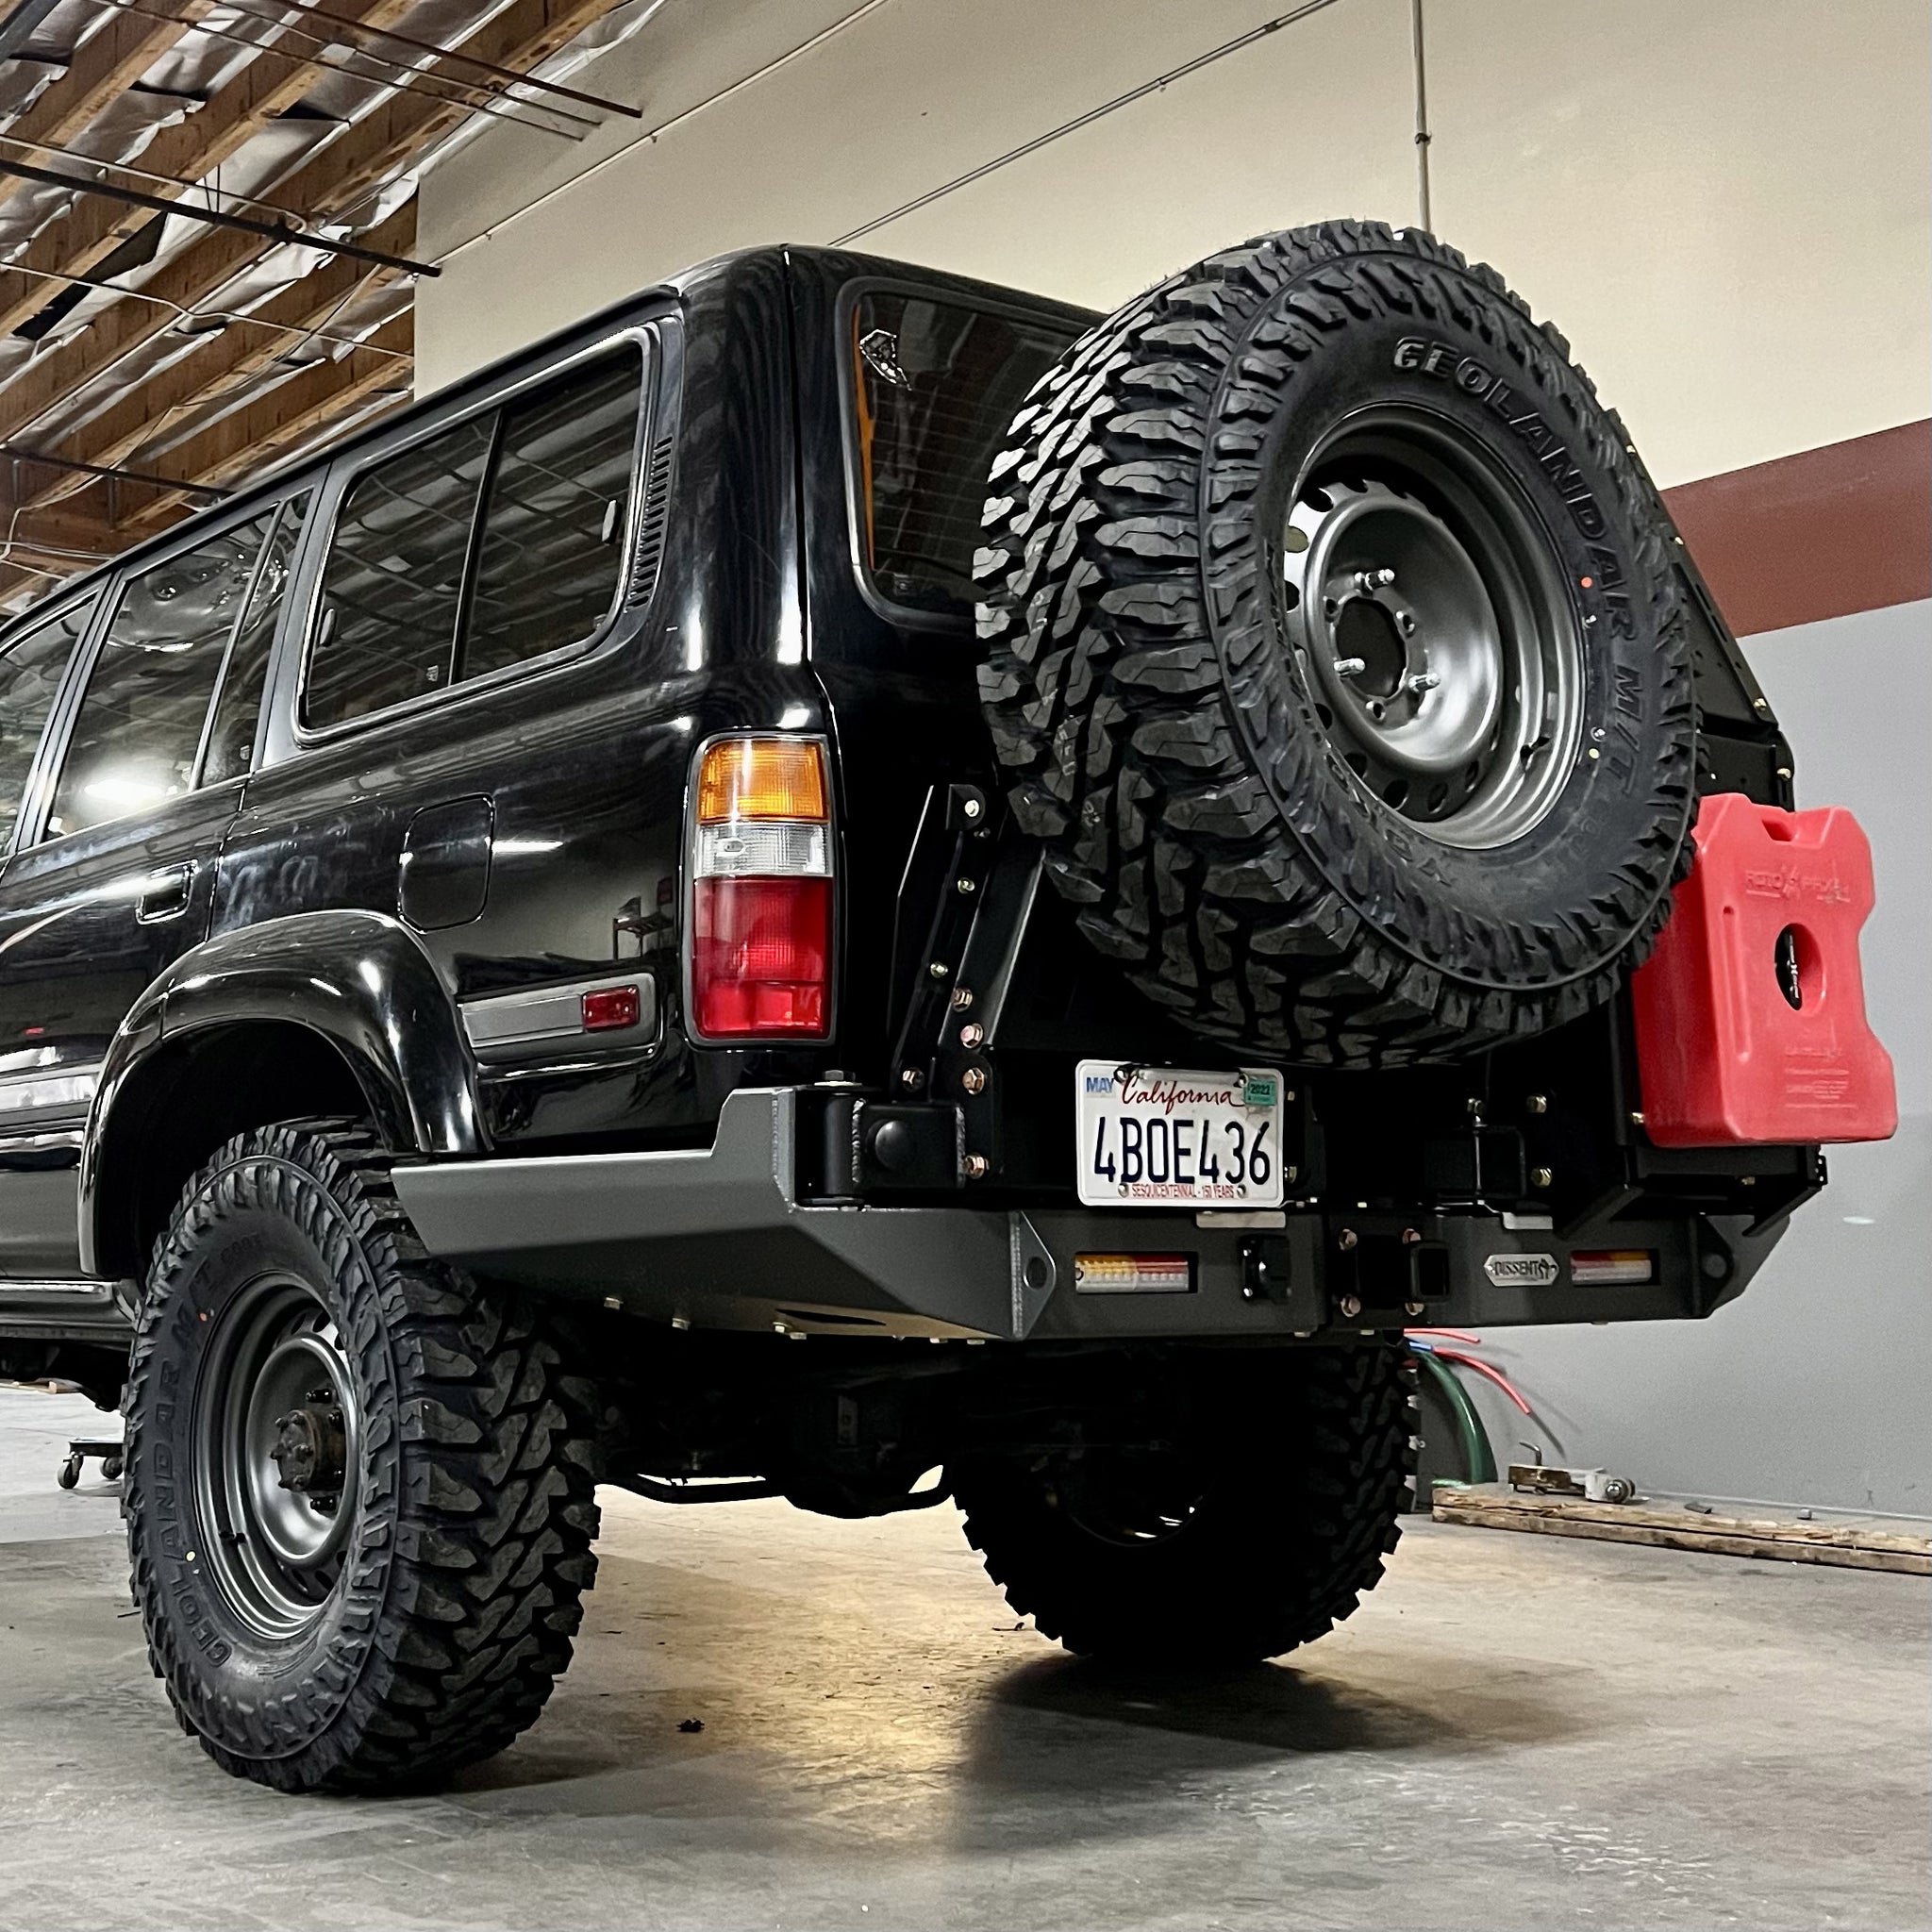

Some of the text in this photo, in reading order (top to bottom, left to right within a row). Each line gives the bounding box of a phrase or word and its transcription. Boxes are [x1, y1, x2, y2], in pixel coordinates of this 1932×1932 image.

[1394, 336, 1637, 641] GEOLANDAR
[1086, 1076, 1114, 1093] MAY
[1122, 1074, 1245, 1115] California
[1094, 1117, 1270, 1185] 4BOE436
